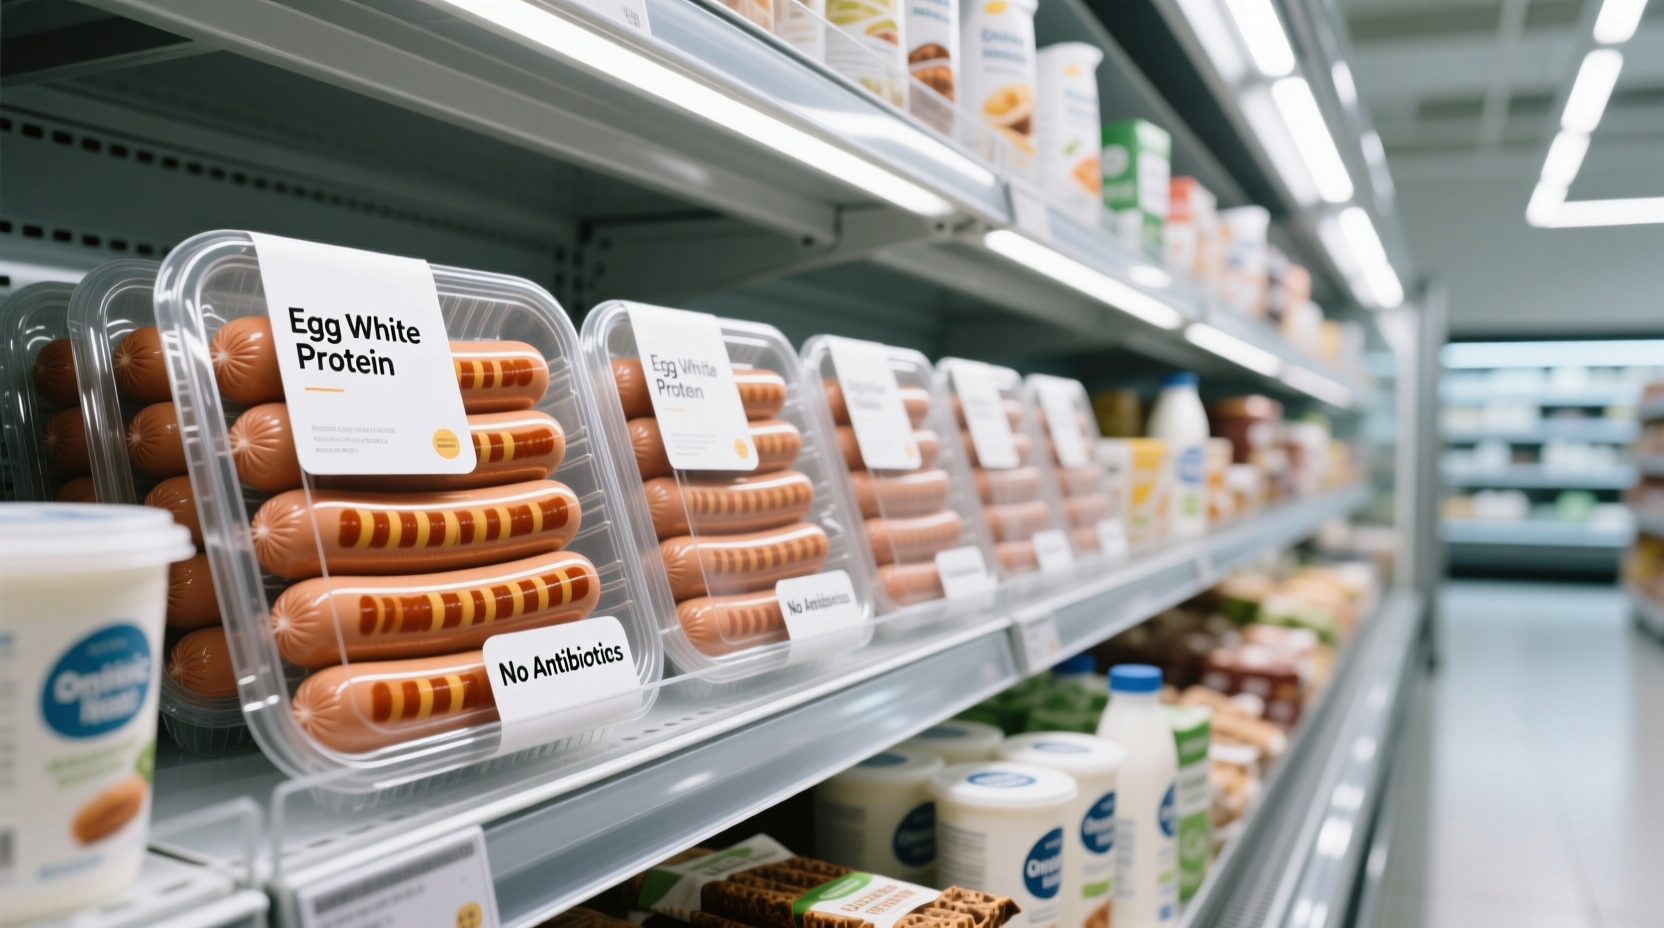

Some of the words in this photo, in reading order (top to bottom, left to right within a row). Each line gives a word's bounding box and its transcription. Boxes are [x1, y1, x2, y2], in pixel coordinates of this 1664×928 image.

[288, 306, 342, 344] Egg
[344, 313, 421, 345] White
[296, 342, 395, 376] Protein
[650, 354, 678, 379] Egg
[787, 598, 803, 617] No
[498, 660, 529, 686] No
[533, 641, 624, 679] Antibiotics
